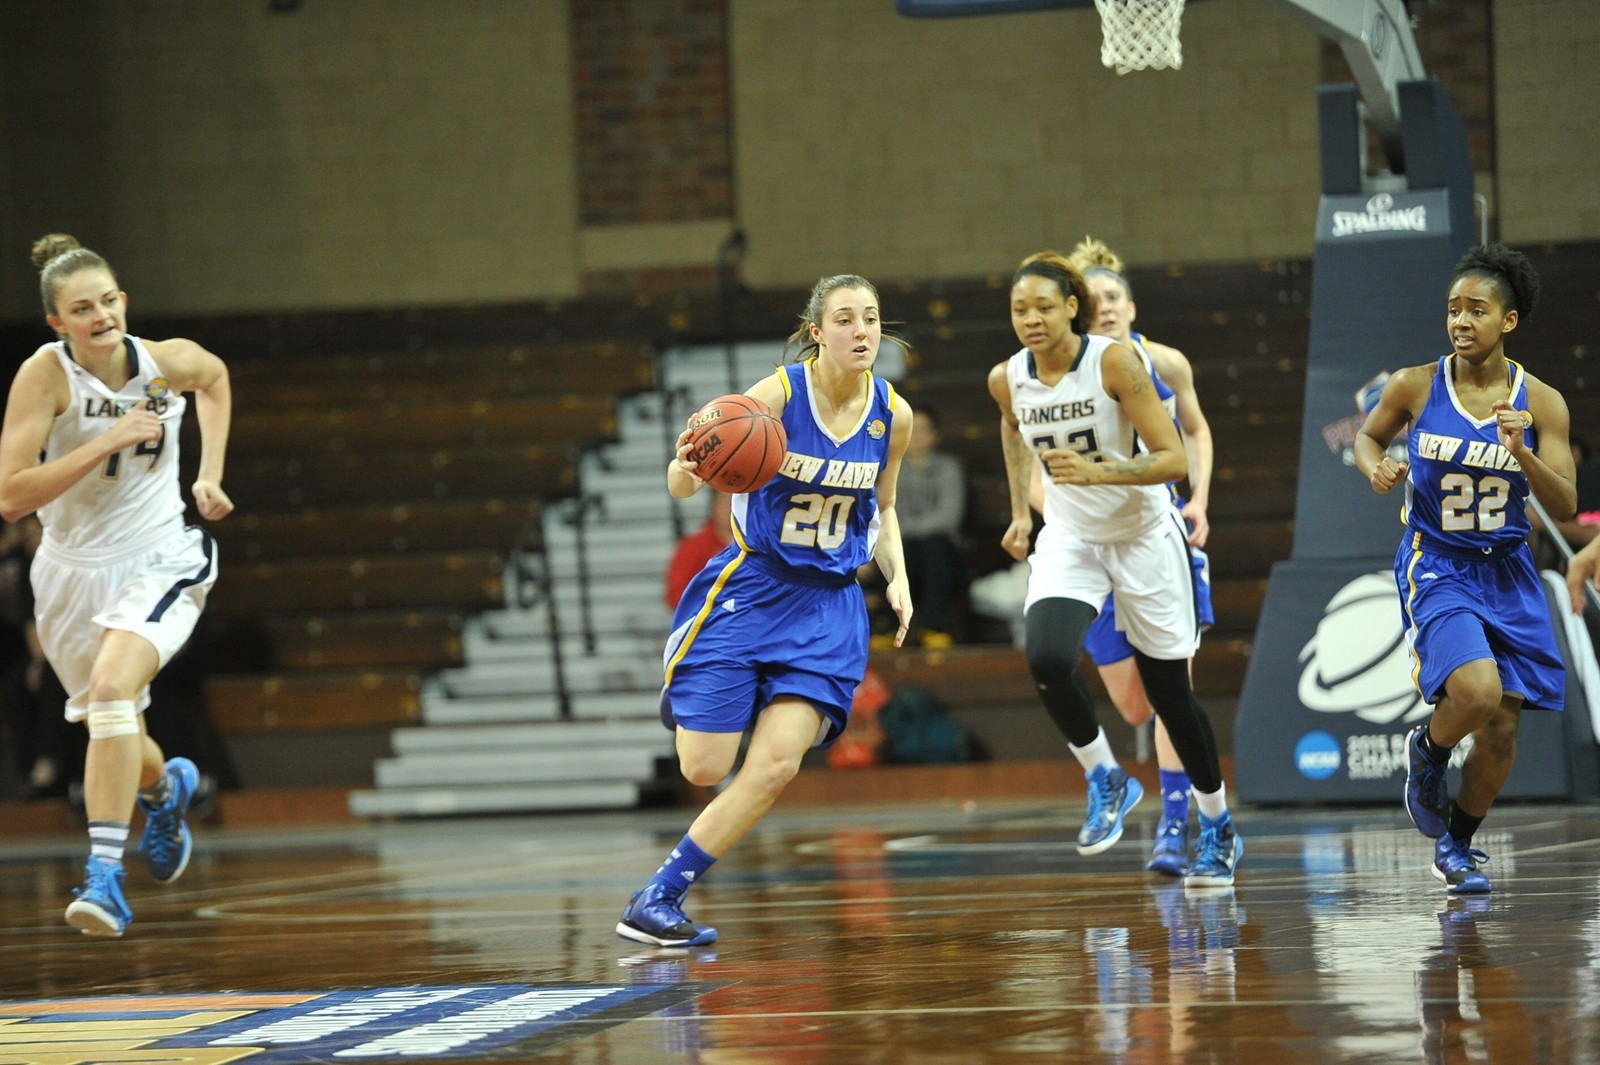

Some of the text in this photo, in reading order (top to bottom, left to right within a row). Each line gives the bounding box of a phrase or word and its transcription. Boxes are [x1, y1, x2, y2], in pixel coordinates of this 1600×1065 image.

[1332, 205, 1427, 237] SPALDING
[85, 397, 168, 417] LANRS
[1020, 398, 1095, 425] LANCERS
[1418, 432, 1463, 462] NEW
[1440, 472, 1511, 532] 22
[780, 493, 855, 550] 20
